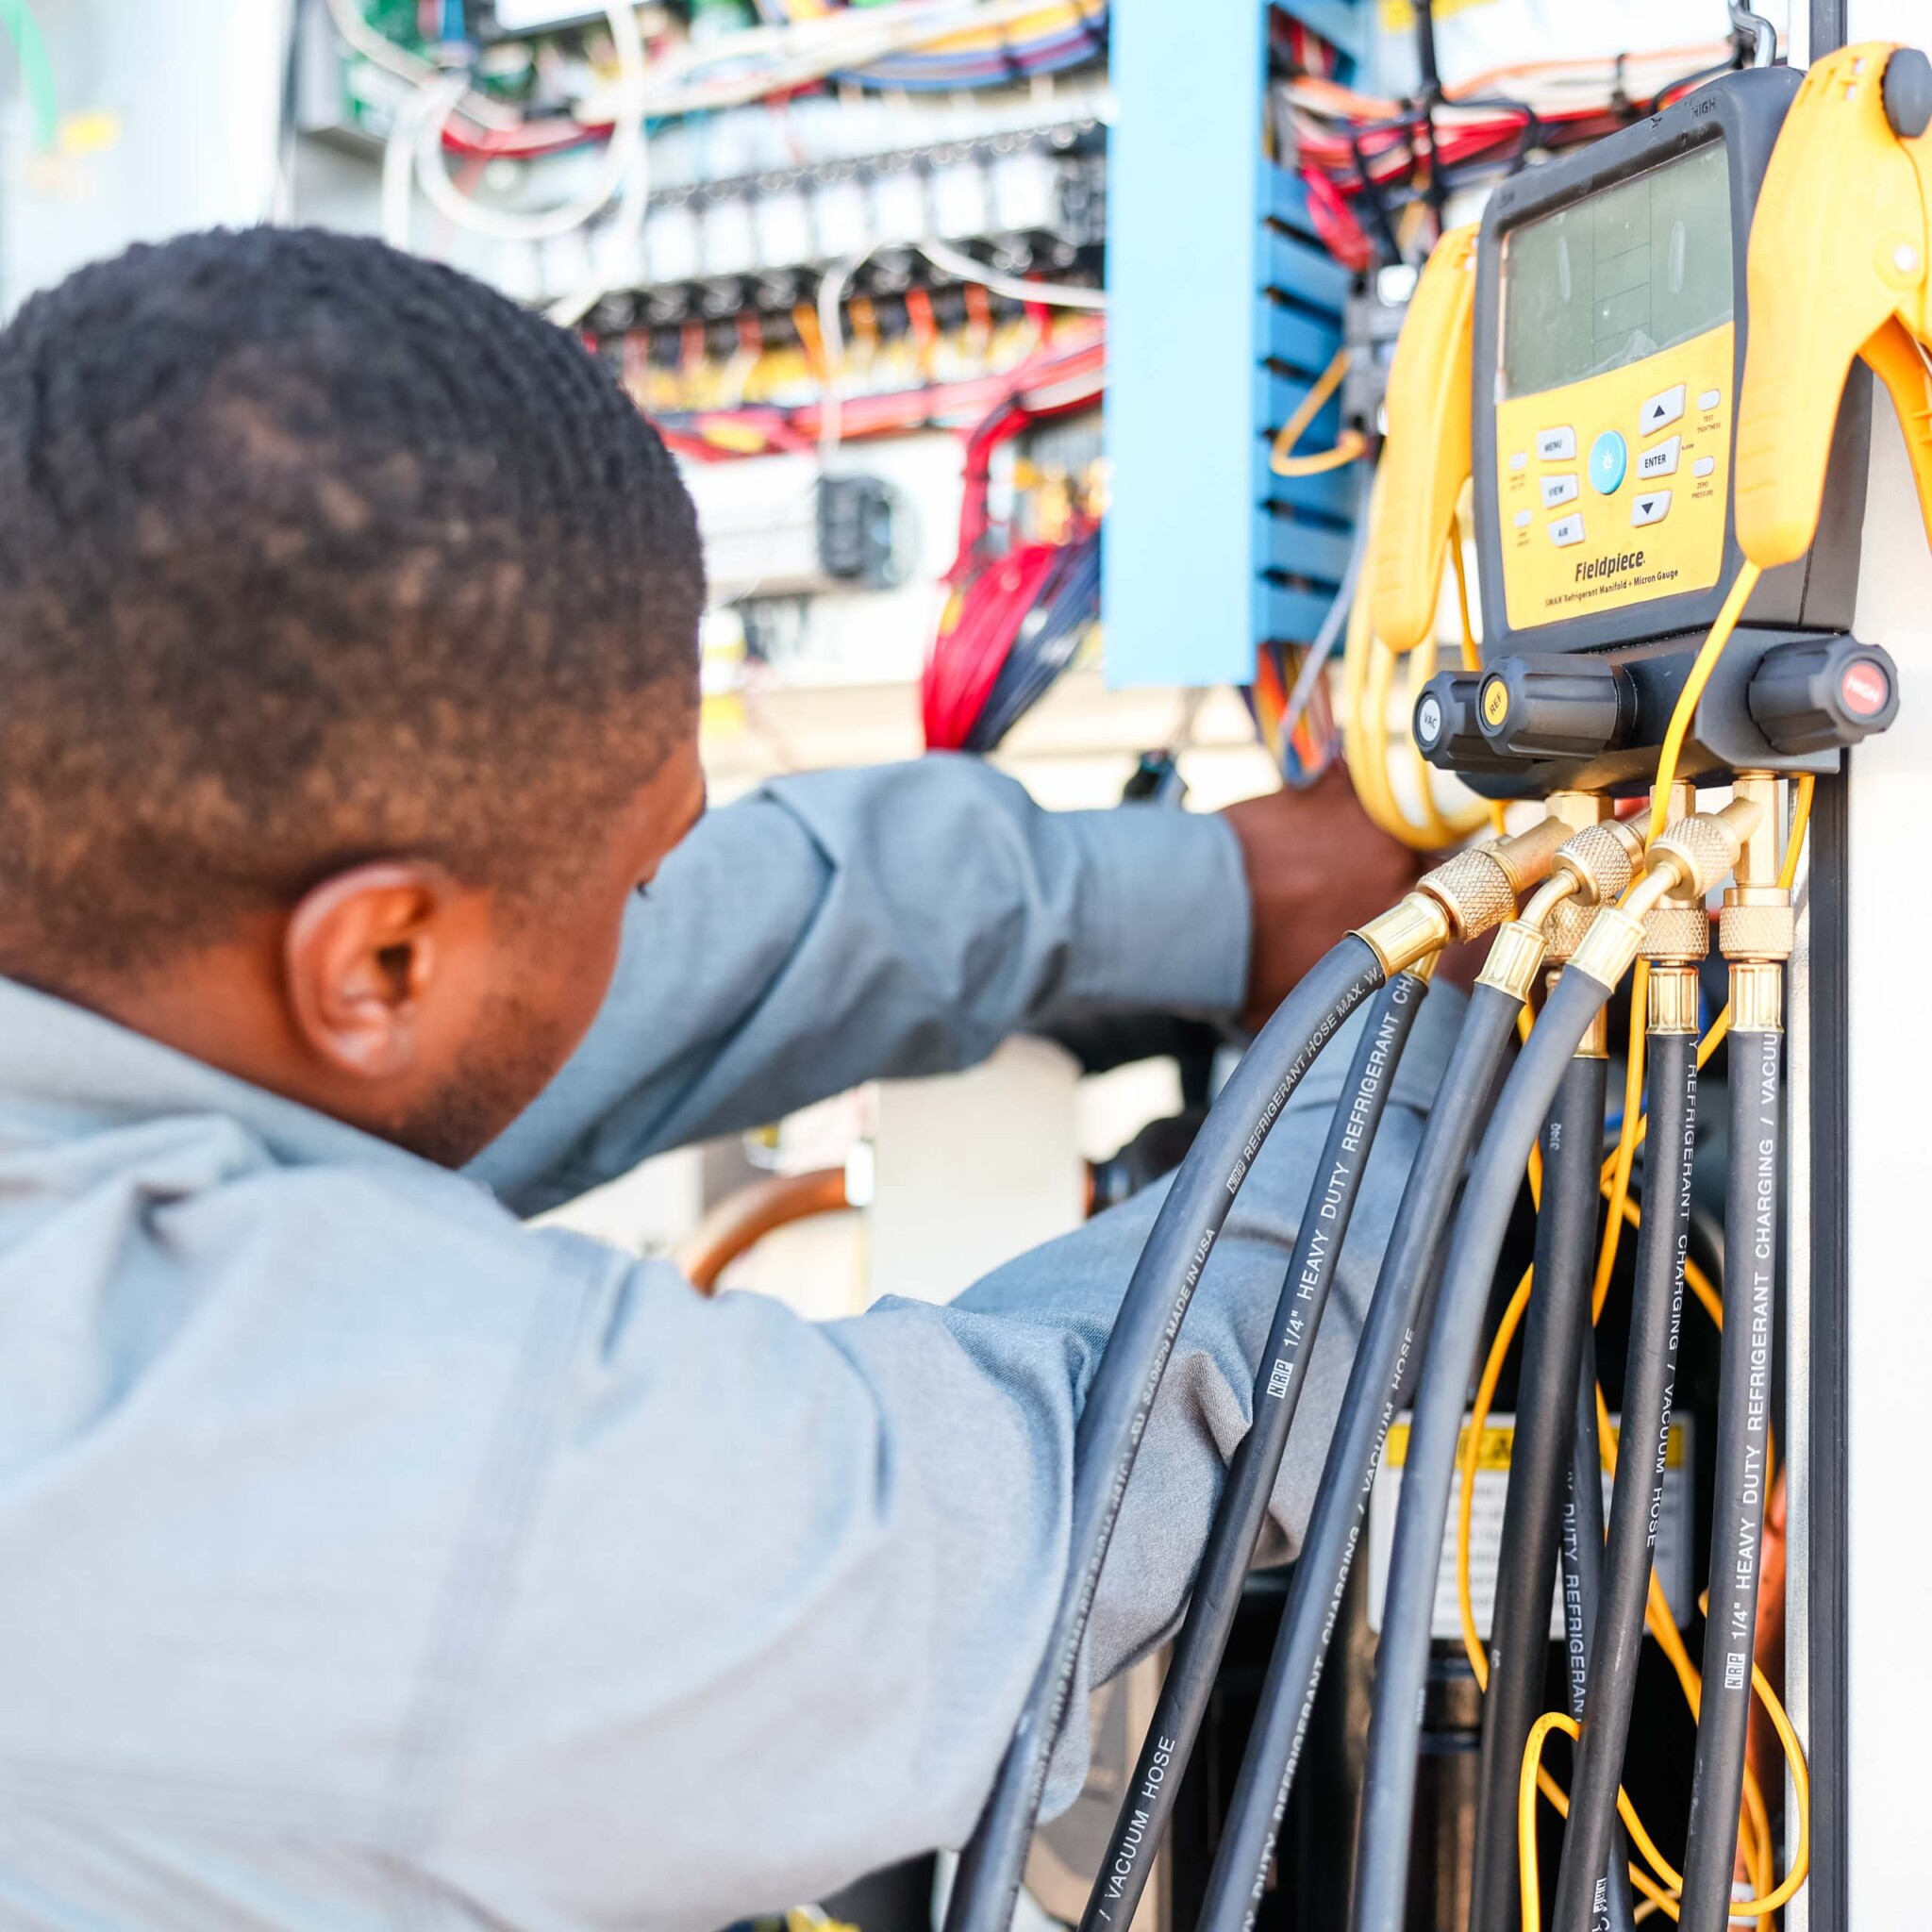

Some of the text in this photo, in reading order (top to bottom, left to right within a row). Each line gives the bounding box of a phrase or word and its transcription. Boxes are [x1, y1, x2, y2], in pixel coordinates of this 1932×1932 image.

[1691, 97, 1716, 120] HIGH
[1544, 439, 1562, 452] MENU
[1644, 454, 1666, 468] ENTER
[1548, 485, 1564, 497] VIEW
[1557, 527, 1568, 538] AIR
[1564, 587, 1598, 603] Refrigerant
[1599, 579, 1627, 594] Manifold
[1634, 574, 1656, 587] Micron
[1657, 569, 1678, 580] Gauge
[1574, 550, 1644, 583] Fieldpiece
[1424, 712, 1437, 729] VAC
[1490, 691, 1502, 716] REF
[1846, 675, 1879, 705] HIGH
[1242, 1056, 1306, 1160] REFRIGERANT
[1305, 1012, 1337, 1058] HOSE
[1336, 982, 1365, 1017] MAX.
[1297, 1228, 1329, 1300] HEAVY
[1321, 1160, 1350, 1220] DUTY
[1341, 1011, 1400, 1153] REFRIGERANT
[1679, 1063, 1698, 1222] REFRIGERANT
[1756, 1139, 1774, 1259] CHARGING
[1166, 1285, 1191, 1338] MADE
[1186, 1264, 1199, 1288] IN
[1195, 1228, 1216, 1265] USA
[1669, 1234, 1689, 1351] CHARGING
[1748, 1272, 1769, 1432] REFRIGERANT
[1656, 1384, 1674, 1474] VACUUM
[1322, 1525, 1359, 1645] CHARGING
[1362, 1401, 1394, 1492] VACUUM
[1391, 1327, 1415, 1390] HOSE
[1742, 1445, 1761, 1505] DUTY
[1646, 1488, 1662, 1548] HOSE
[1736, 1517, 1757, 1590] HEAVY
[1563, 1504, 1587, 1723] DUTY REFRIGERAN
[1105, 1809, 1150, 1899] VACUUM
[1141, 1736, 1176, 1800] HOSE
